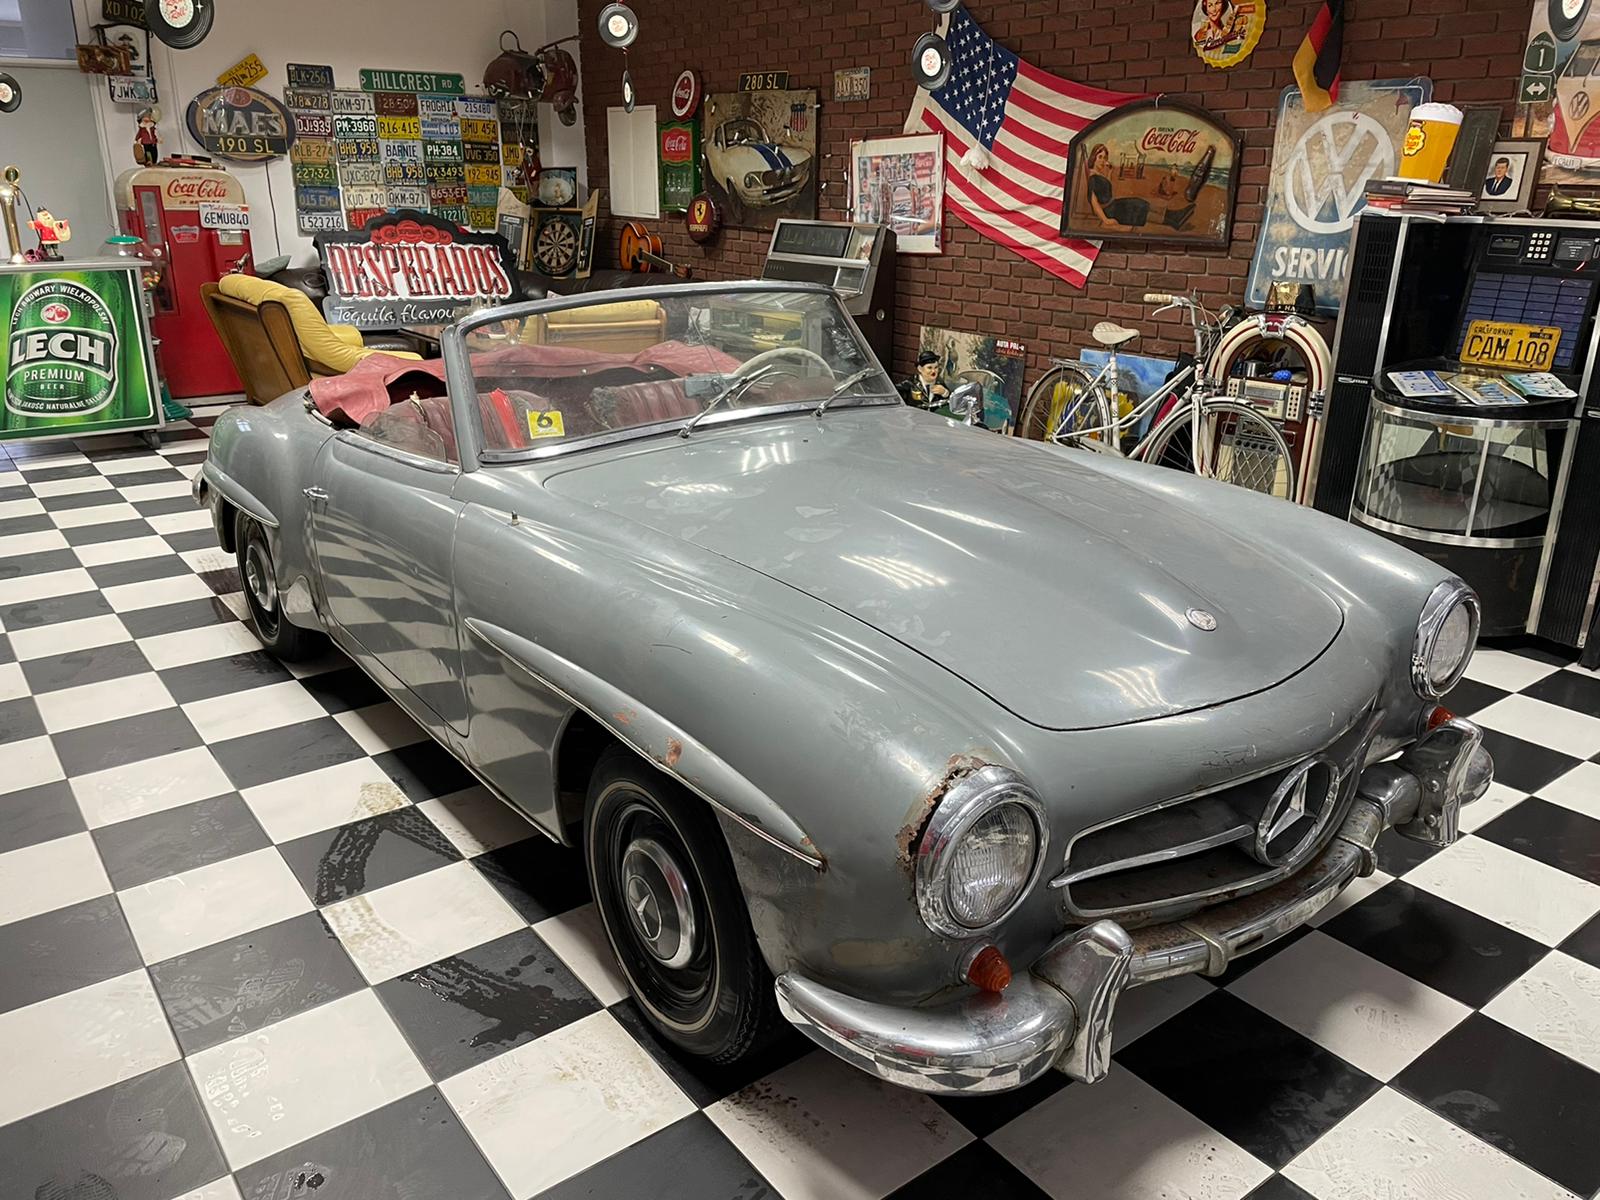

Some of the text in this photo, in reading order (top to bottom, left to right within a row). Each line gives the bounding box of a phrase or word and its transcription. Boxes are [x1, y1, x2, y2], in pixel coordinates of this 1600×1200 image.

[1539, 48, 1545, 67] 1
[372, 71, 437, 91] HILLCREST
[744, 73, 779, 91] 280 SL
[202, 109, 282, 136] MAES
[219, 138, 274, 153] 190 SL
[1142, 127, 1201, 153] Coca-Cola
[167, 178, 227, 198] Coca-Cola
[327, 244, 511, 297] DESPERADOS
[334, 303, 455, 326] Tequila flavou
[11, 332, 105, 367] LECH
[1467, 335, 1550, 366] CAM 108
[24, 368, 85, 382] PREMIUM
[537, 412, 553, 428] 6
